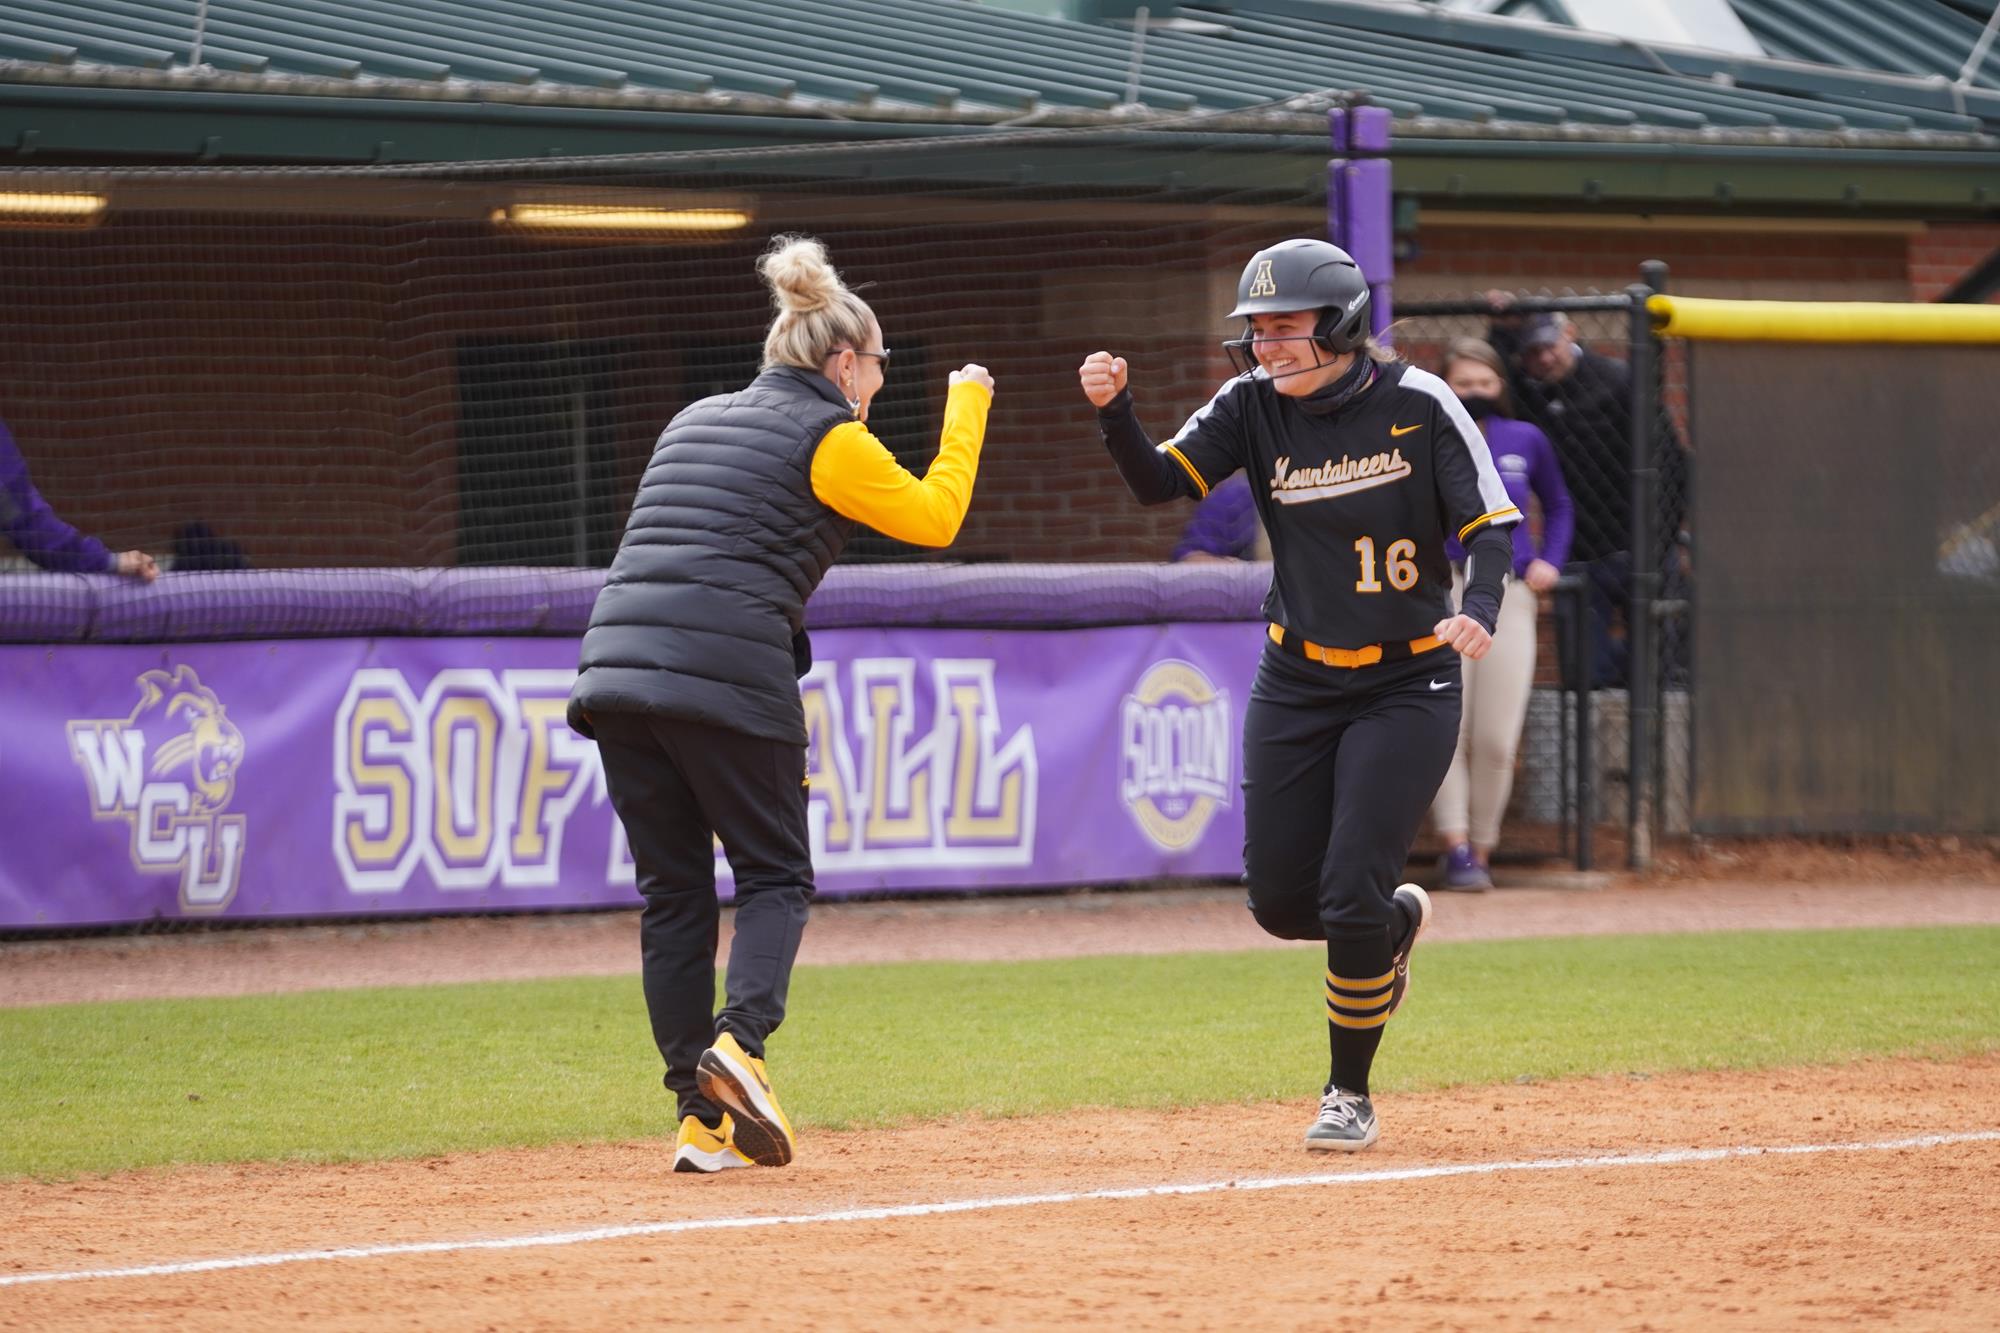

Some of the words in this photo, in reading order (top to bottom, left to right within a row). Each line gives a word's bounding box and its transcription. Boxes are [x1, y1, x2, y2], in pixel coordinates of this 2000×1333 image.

[1249, 259, 1276, 297] A
[1270, 448, 1405, 489] Mountaineers
[1355, 535, 1419, 593] 16
[333, 658, 1038, 893] SOFALL
[67, 719, 247, 915] WCU
